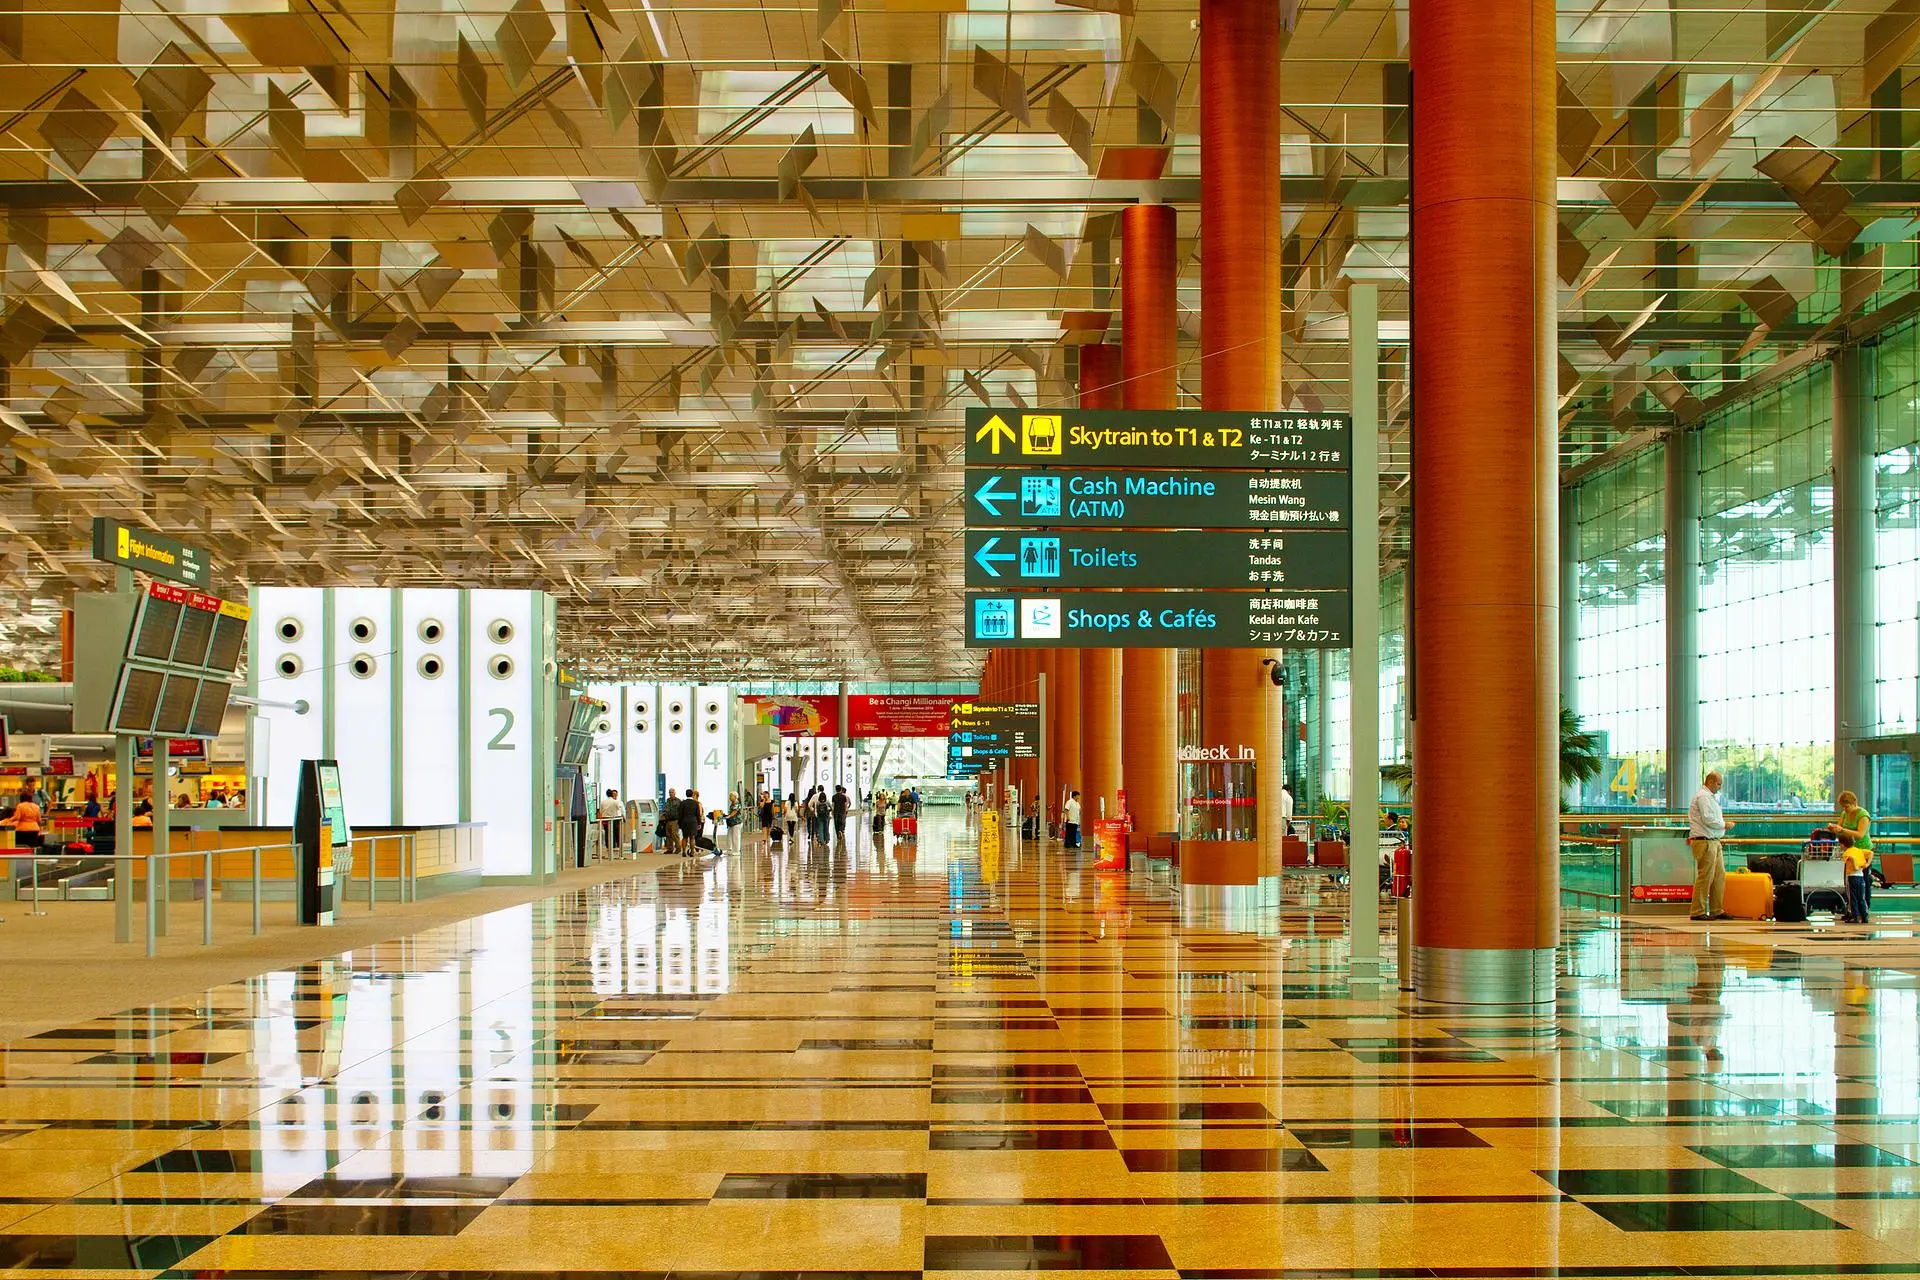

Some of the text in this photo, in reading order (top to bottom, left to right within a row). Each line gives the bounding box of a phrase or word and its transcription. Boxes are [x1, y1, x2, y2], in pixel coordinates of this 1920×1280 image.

[1069, 426, 1243, 450] Skytrain to T1 & T2
[1250, 434, 1262, 444] Ke
[1270, 435, 1280, 444] T1
[1283, 436, 1290, 445] &
[1291, 435, 1303, 445] T2
[1069, 476, 1216, 496] Cash Machine
[1249, 478, 1302, 490] 自动提款机
[1249, 494, 1306, 507] Mesin Wang
[1069, 498, 1125, 519] (ATM)
[1249, 538, 1284, 550] 洗手间
[130, 539, 145, 558] Flight
[146, 545, 175, 565] Information
[1069, 547, 1138, 567] Toilets
[1249, 554, 1282, 565] Tandas
[1249, 570, 1285, 582] お手洗
[1249, 598, 1319, 610] 商店和咖啡座
[1067, 608, 1217, 633] Shops & Cafés
[1249, 614, 1319, 625] Kedai dan Kafe
[869, 697, 879, 705] Be
[886, 697, 912, 707] Changi
[488, 708, 515, 750] 2
[1239, 744, 1255, 760] In
[704, 748, 720, 770] 4
[821, 769, 829, 781] 6
[846, 773, 853, 783] 8
[1611, 759, 1636, 799] 4
